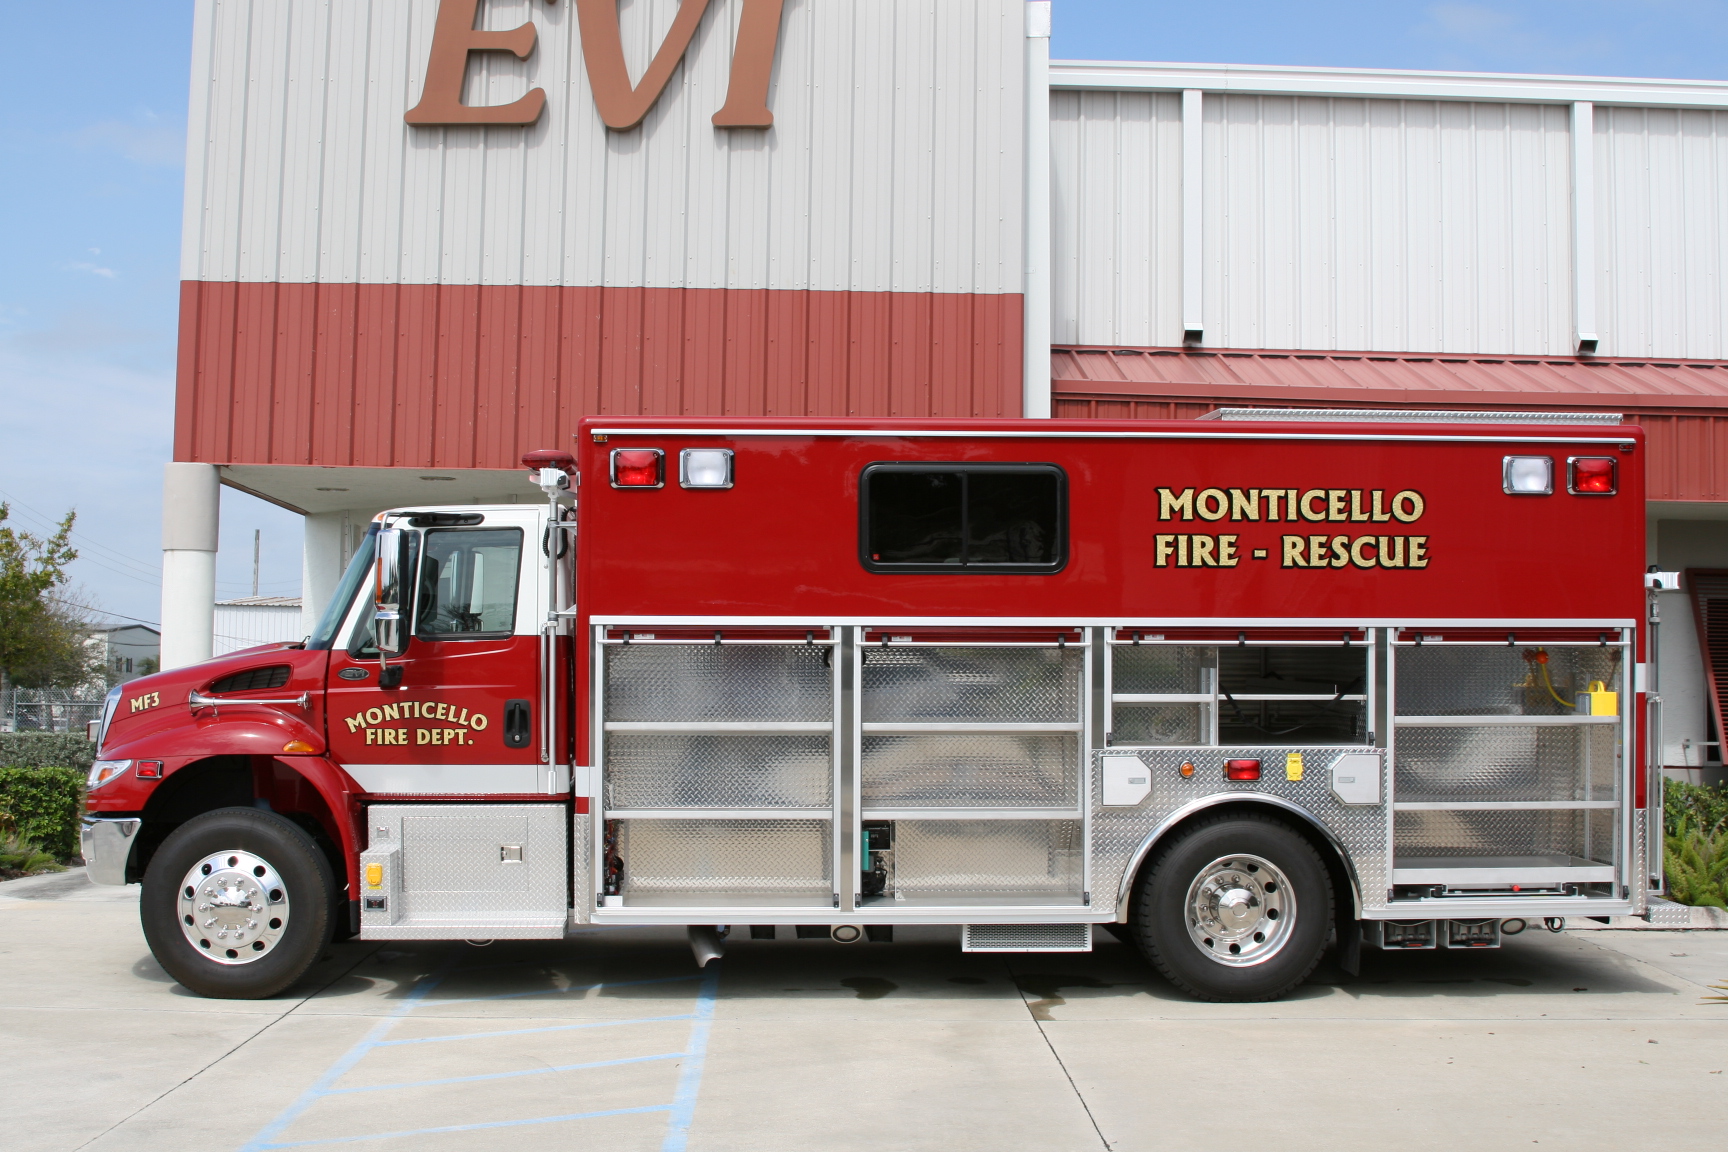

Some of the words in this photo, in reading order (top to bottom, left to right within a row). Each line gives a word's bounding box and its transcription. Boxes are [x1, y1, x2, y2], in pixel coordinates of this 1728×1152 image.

[404, 0, 784, 130] EVI
[1156, 488, 1425, 522] MONTICELLO
[1154, 534, 1239, 567] FIRE
[1281, 535, 1429, 568] RESCUE
[130, 691, 160, 714] MF3
[345, 701, 488, 733] MONTICELLO
[366, 728, 408, 746] FIRE
[416, 729, 474, 746] DEPT.
